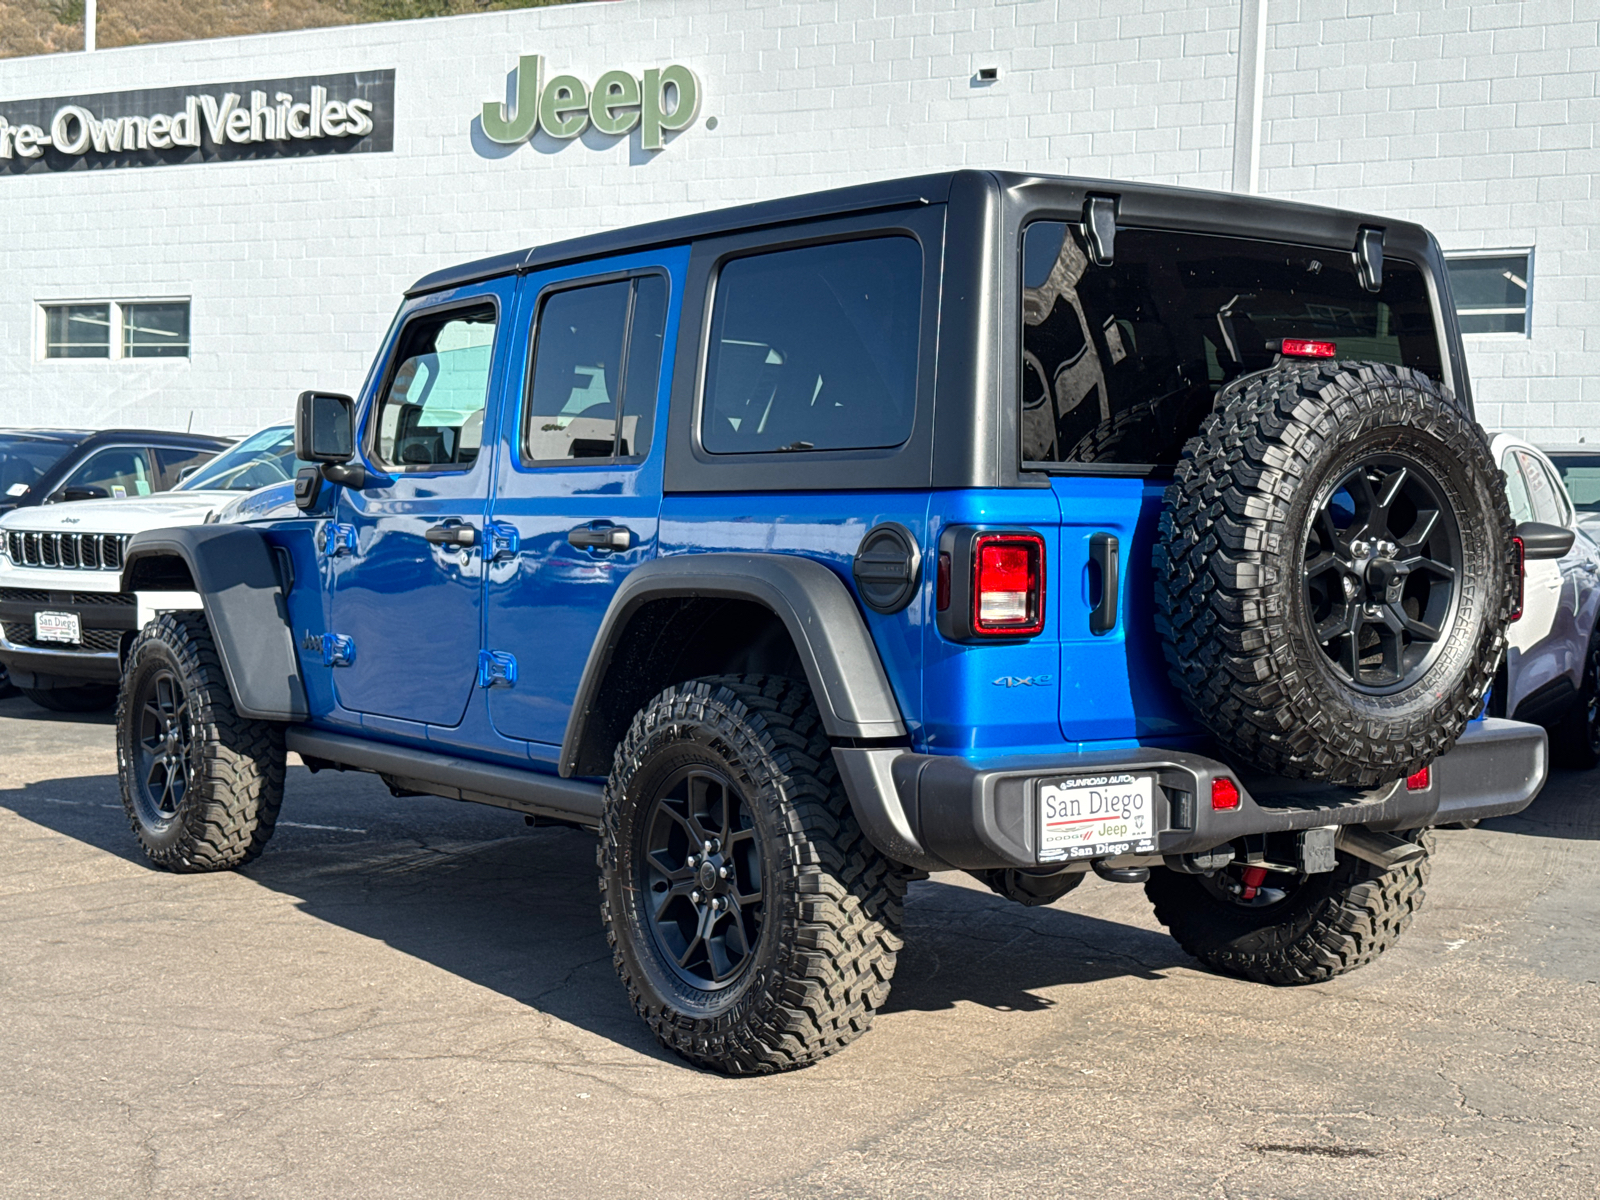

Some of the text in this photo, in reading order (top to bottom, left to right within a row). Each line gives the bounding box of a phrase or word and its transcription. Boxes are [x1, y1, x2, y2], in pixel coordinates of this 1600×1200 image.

[481, 55, 702, 150] Jeep
[199, 84, 373, 145] Vehicles
[39, 616, 76, 631] San Diego
[1066, 775, 1131, 787] SUNROAD AUTO
[1046, 788, 1143, 820] San Diego
[1098, 823, 1127, 837] Jeep
[1070, 846, 1093, 858] San
[1096, 843, 1129, 855] Diego
